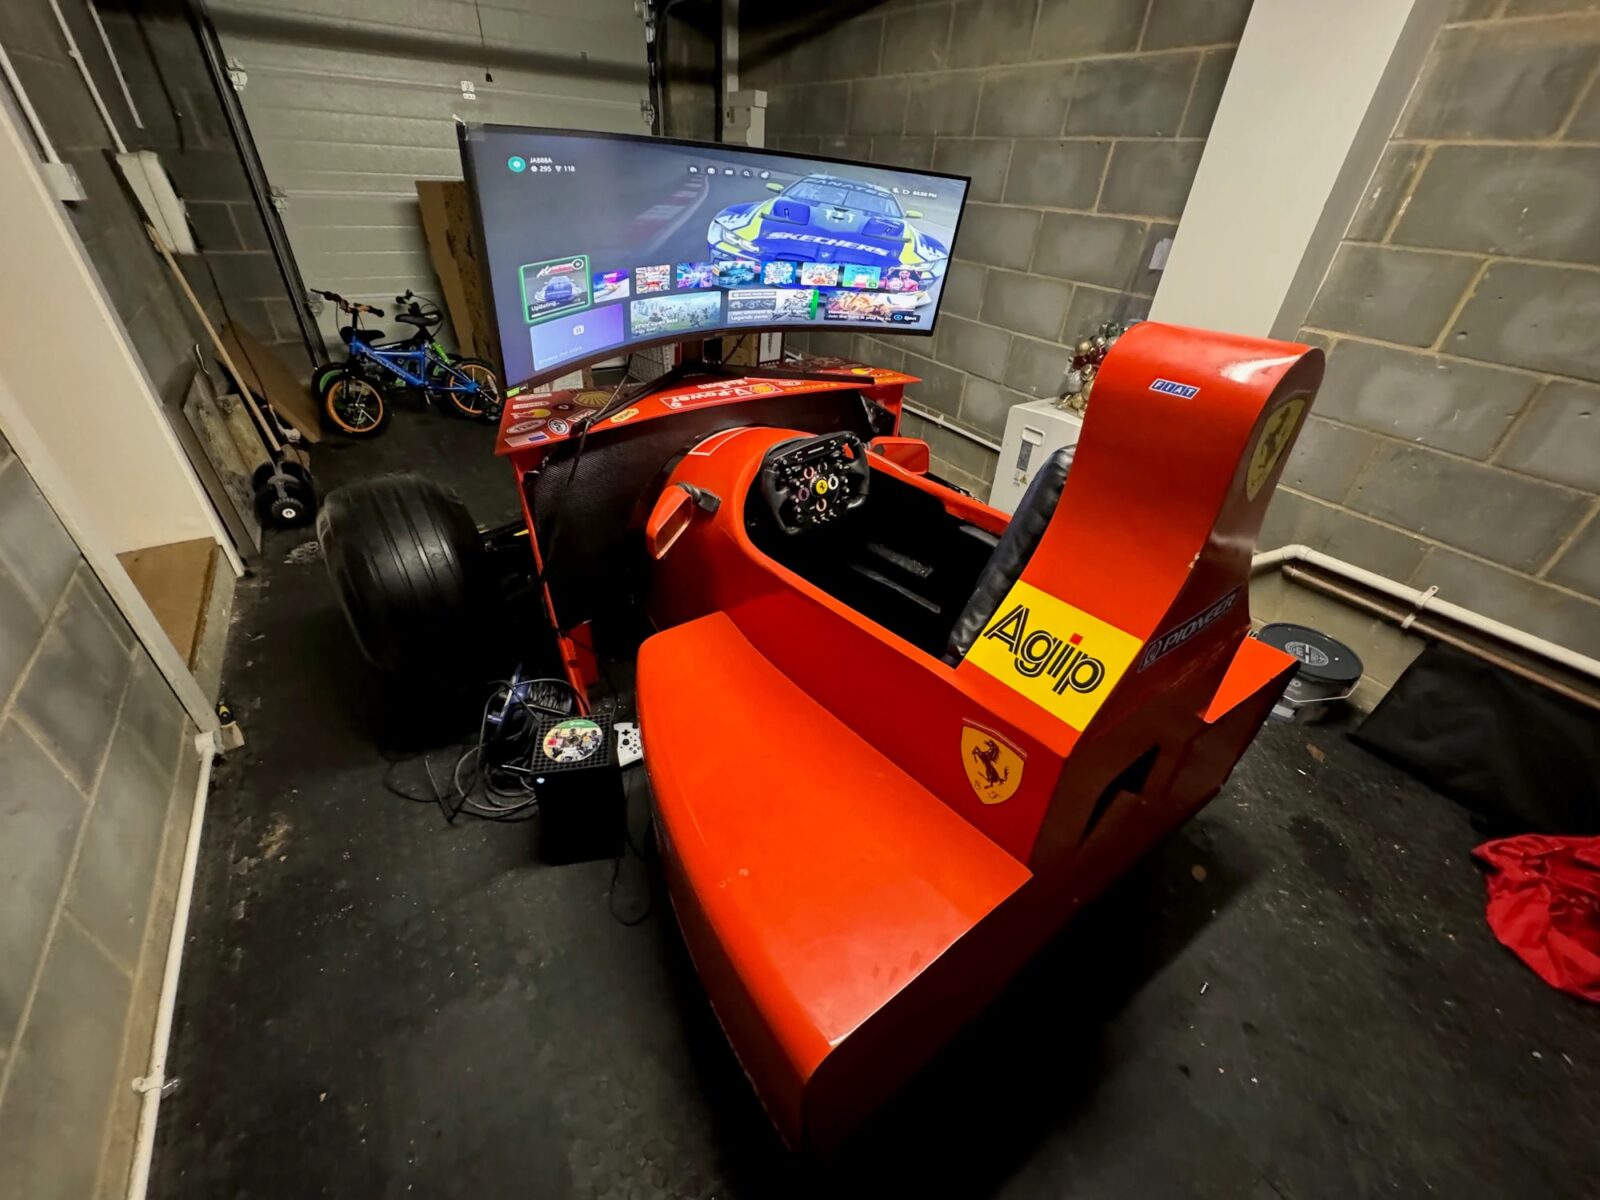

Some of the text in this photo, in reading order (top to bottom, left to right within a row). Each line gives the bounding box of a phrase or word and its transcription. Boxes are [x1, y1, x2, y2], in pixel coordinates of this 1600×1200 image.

[803, 178, 890, 198] FANATEC
[766, 232, 890, 257] SKECHERS
[671, 387, 752, 403] V-Power
[1154, 381, 1196, 396] FIAT
[1162, 592, 1236, 653] PIONEER
[983, 604, 1106, 696] Agip
